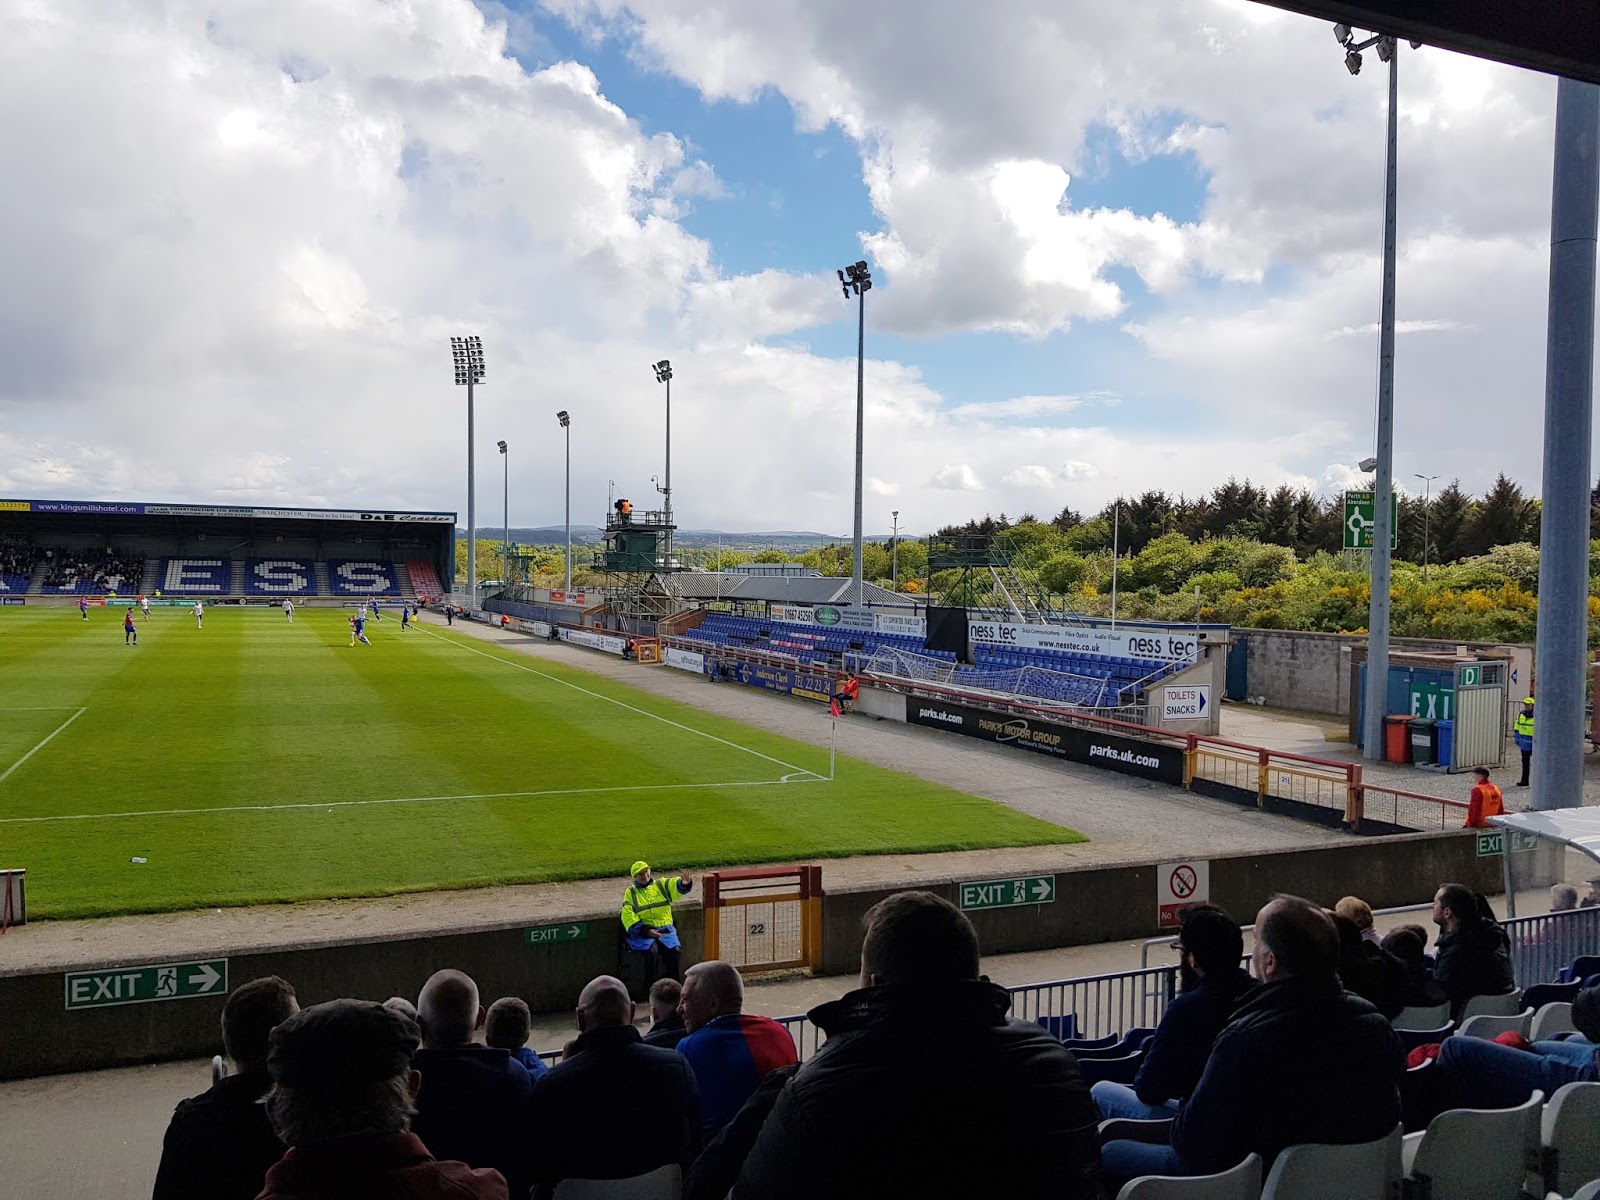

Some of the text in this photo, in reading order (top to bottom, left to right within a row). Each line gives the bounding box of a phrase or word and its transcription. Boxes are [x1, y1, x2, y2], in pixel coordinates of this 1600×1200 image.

[38, 503, 137, 513] www.kingsmillshotel.com
[970, 624, 1017, 640] ness tec
[1076, 631, 1089, 639] Optics
[1038, 640, 1100, 652] www.nesstec.co.uk
[1128, 637, 1194, 656] ness tec
[794, 674, 831, 693] TEL 22 23 24
[1465, 668, 1475, 685] D
[1167, 690, 1196, 700] TOILETS
[1166, 705, 1196, 715] SNACKS
[1411, 691, 1449, 720] EXI
[919, 708, 963, 725] parks.uk.com
[1004, 724, 1031, 740] MOTOR
[1032, 731, 1061, 746] GROUP
[1090, 744, 1159, 769] parks.uk.com
[1479, 836, 1502, 853] EXI
[963, 884, 1006, 906] EXIT
[1161, 911, 1172, 920] No
[530, 928, 559, 942] EXIT
[751, 923, 764, 935] 22
[71, 973, 142, 1003] EXIT
